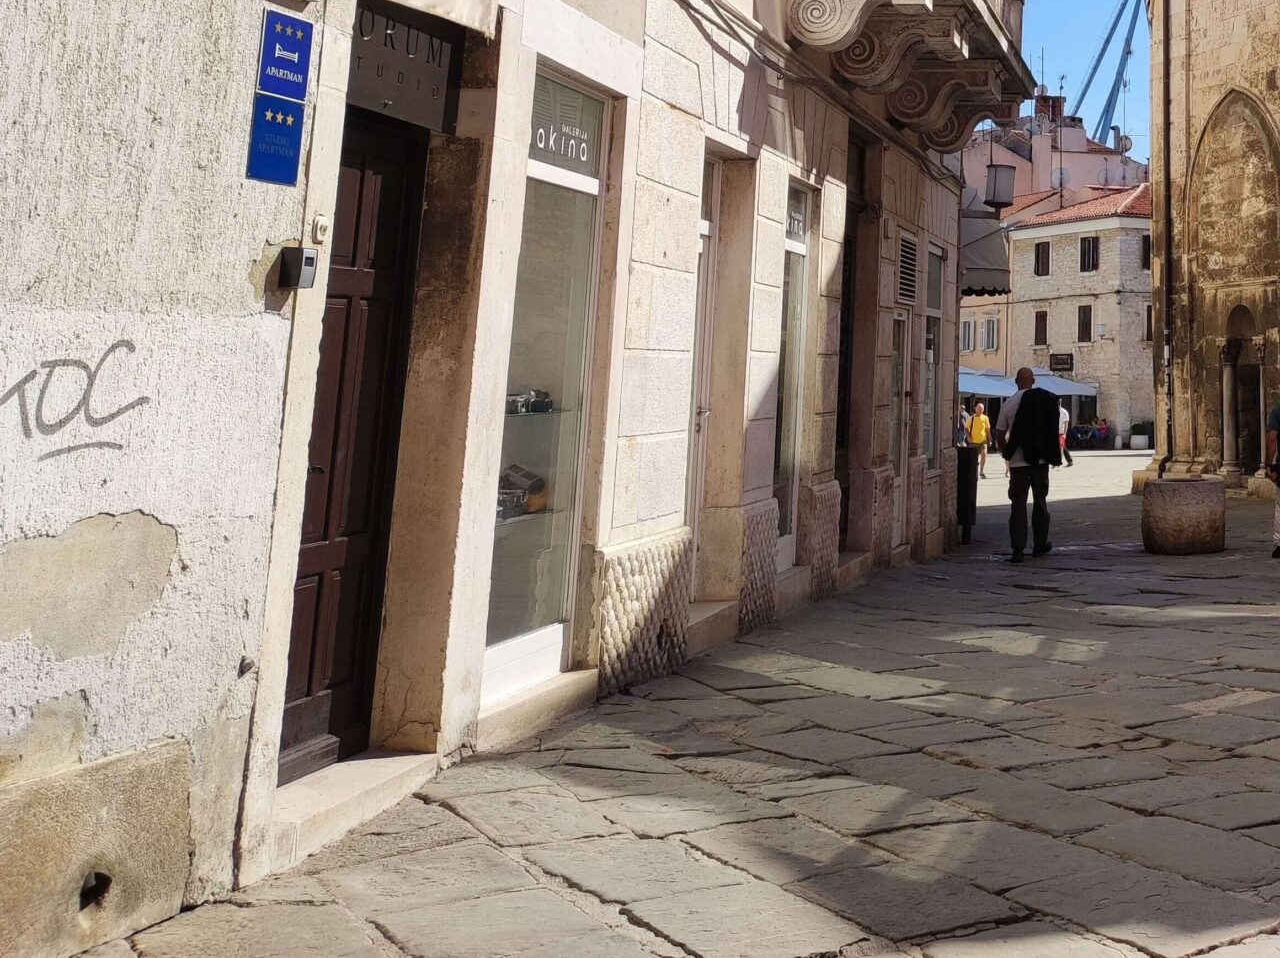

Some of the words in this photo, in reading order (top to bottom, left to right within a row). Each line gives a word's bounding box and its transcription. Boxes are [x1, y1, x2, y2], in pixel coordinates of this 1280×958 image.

[359, 5, 444, 68] ORUM
[265, 66, 303, 83] APARTMAN
[357, 56, 439, 99] TUDIO
[264, 133, 290, 147] STUDIO
[562, 124, 588, 140] GALERIJA
[258, 143, 294, 158] APARTMAN
[537, 125, 587, 162] akina
